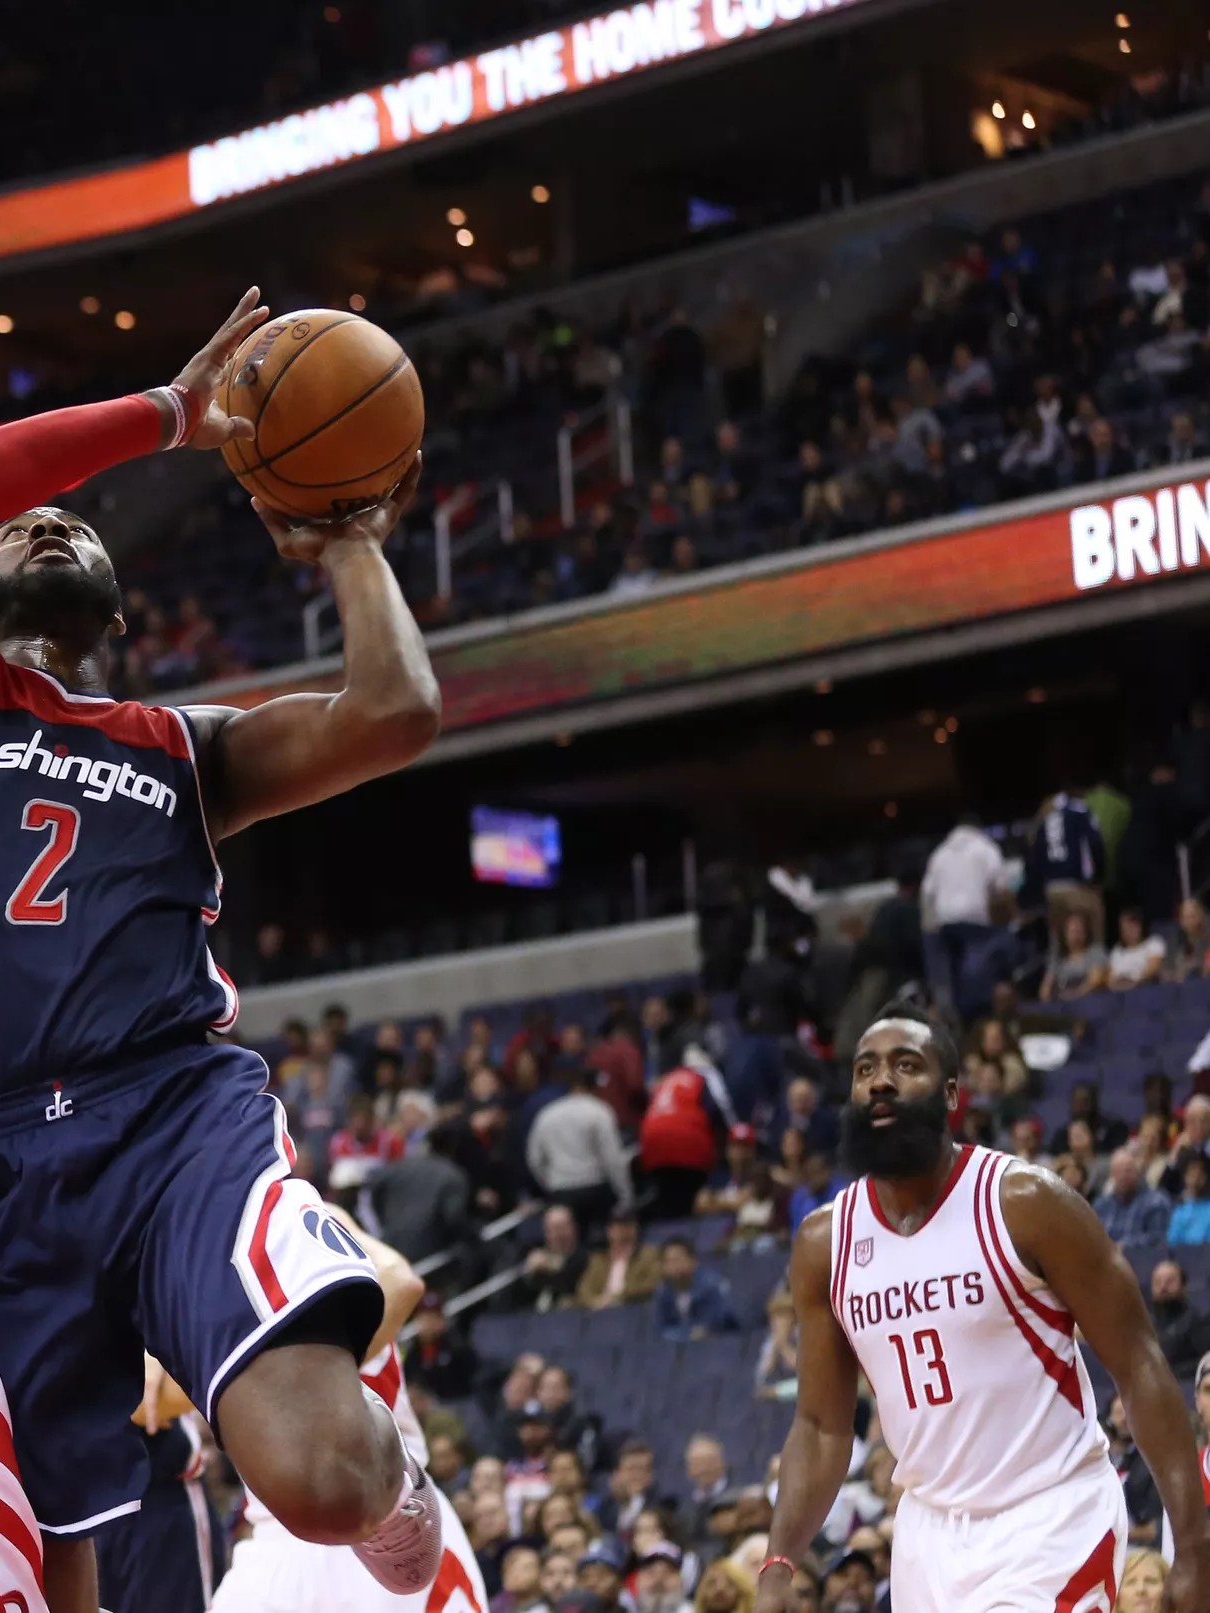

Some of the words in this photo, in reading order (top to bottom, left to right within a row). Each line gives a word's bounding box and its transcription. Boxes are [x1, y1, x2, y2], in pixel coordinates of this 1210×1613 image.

[188, 92, 380, 206] BRINGING
[381, 60, 473, 142] YOU
[477, 31, 567, 112] THE
[572, 0, 705, 84] HOME
[5, 798, 81, 926] 2
[847, 1269, 985, 1333] ROCKETS
[887, 1327, 954, 1410] 13
